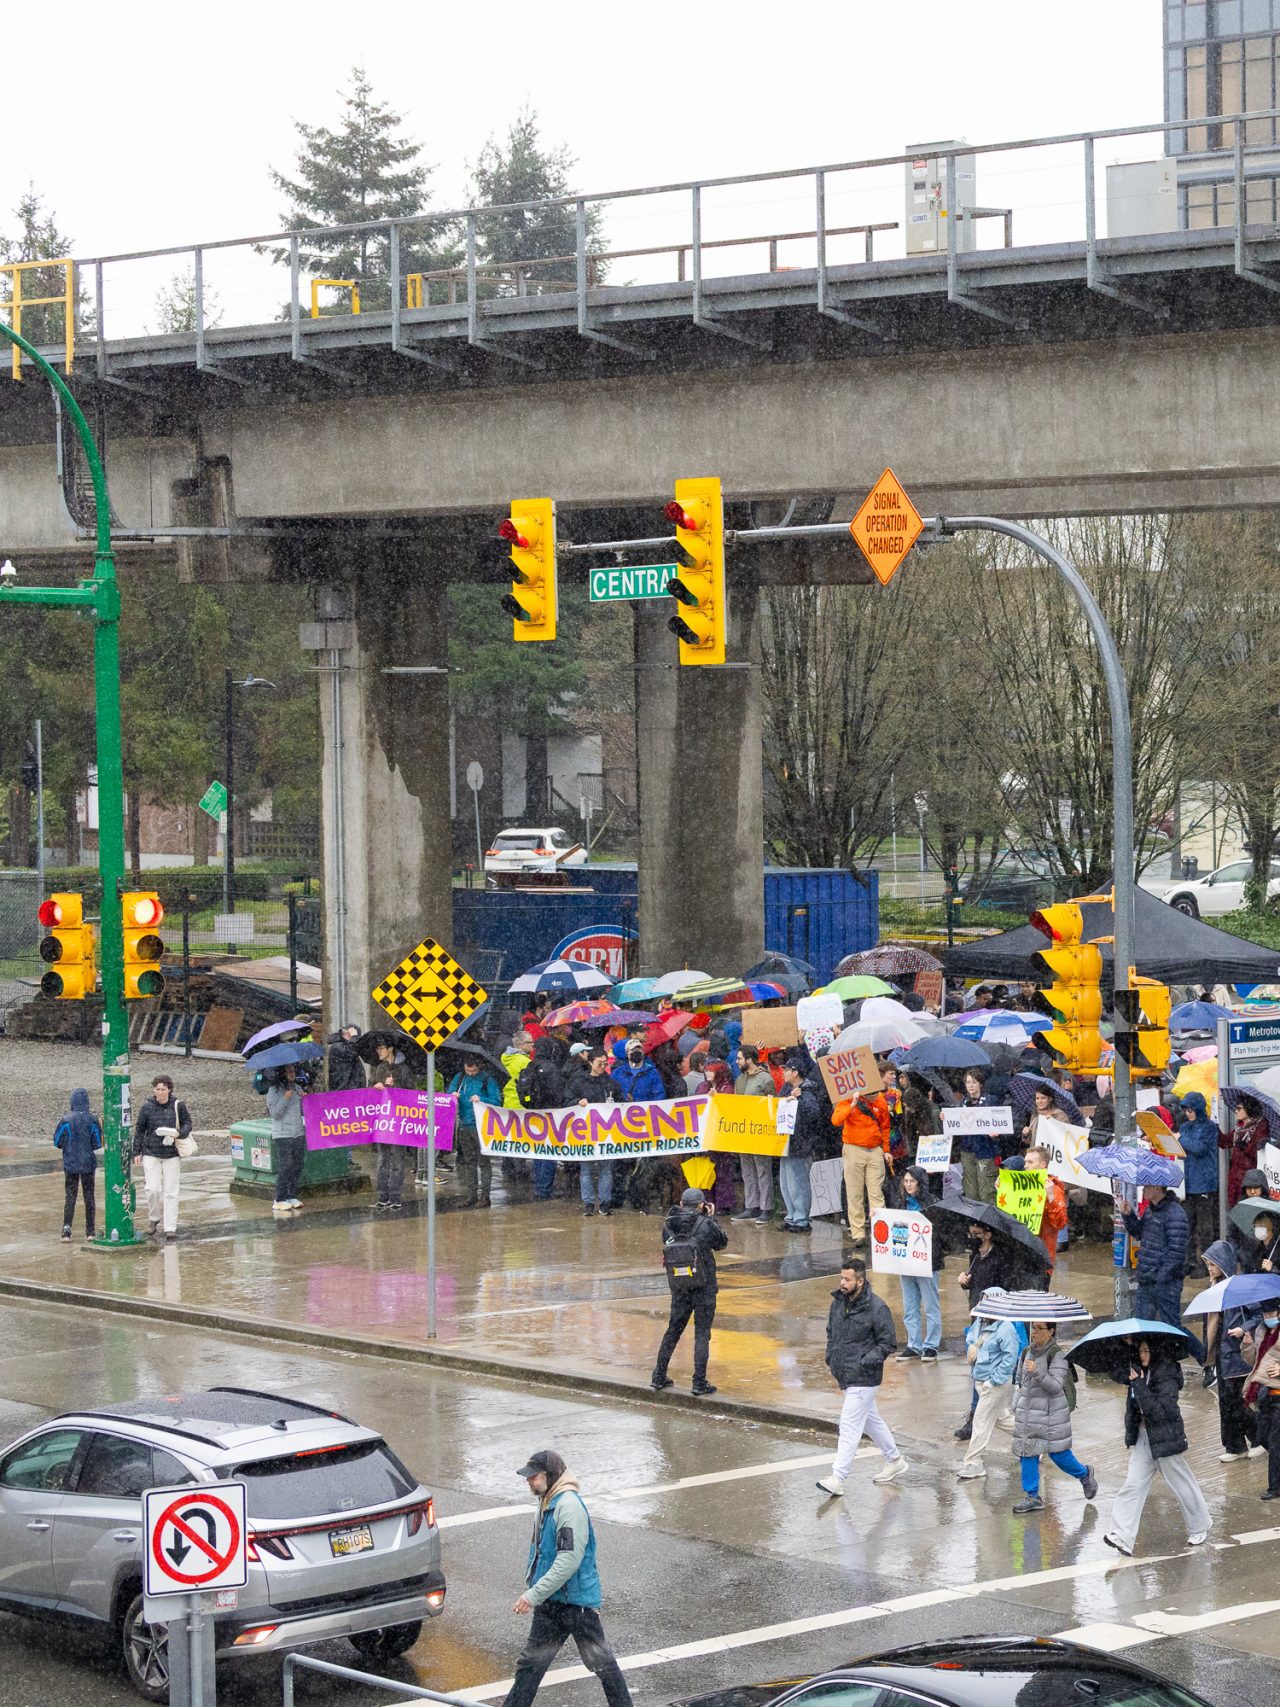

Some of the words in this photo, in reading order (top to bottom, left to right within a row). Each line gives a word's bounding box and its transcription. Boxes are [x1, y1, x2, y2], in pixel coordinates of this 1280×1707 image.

[873, 492, 901, 510] SIGNAL
[866, 514, 907, 533] OPERATION
[868, 536, 904, 554] CHANGED
[1260, 1045, 1271, 1053] Trip
[827, 1051, 860, 1075] SAVE
[834, 1069, 866, 1095] BUS
[325, 1106, 350, 1120] we
[355, 1100, 391, 1117] need
[319, 1120, 373, 1137] buses,
[399, 1118, 440, 1137] fewr
[718, 1117, 746, 1134] fund
[947, 1120, 960, 1128] We
[976, 1119, 991, 1127] the
[992, 1119, 1008, 1127] bus
[491, 1139, 529, 1152] METRO
[534, 1143, 595, 1156] VANCOUVER
[598, 1141, 652, 1155] TRANSIT
[656, 1136, 700, 1150] RIDERS
[1010, 1172, 1044, 1192] HONK
[1018, 1197, 1032, 1208] FOR
[875, 1244, 889, 1254] STOP
[892, 1248, 907, 1257] BUS
[912, 1250, 928, 1261] CUTS
